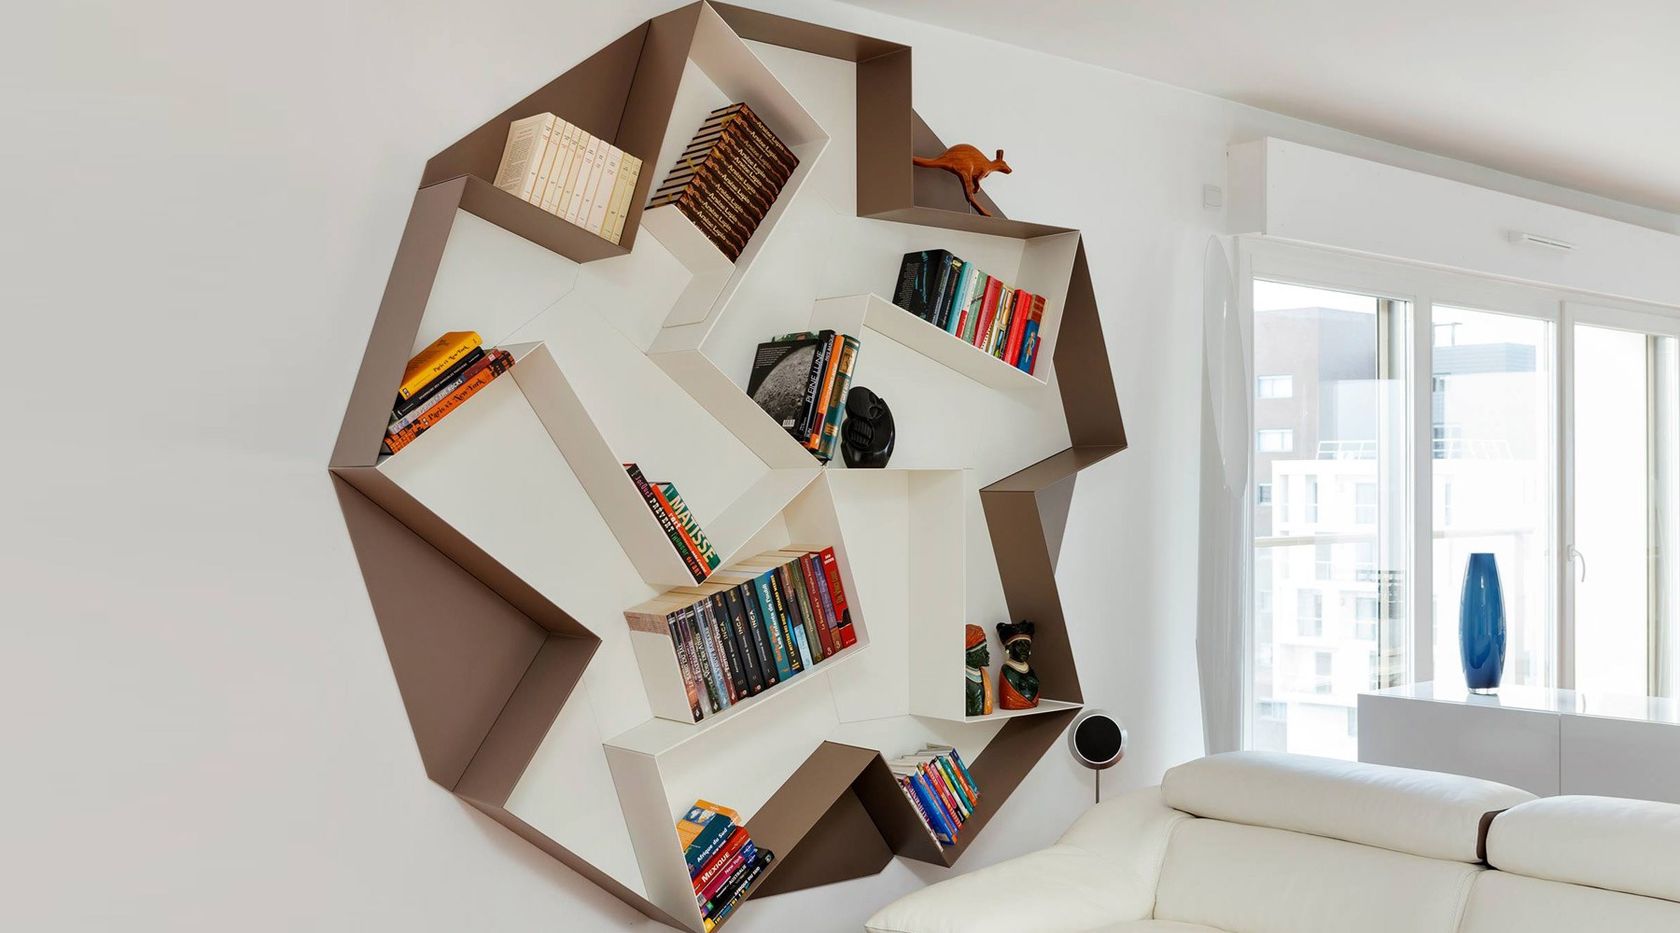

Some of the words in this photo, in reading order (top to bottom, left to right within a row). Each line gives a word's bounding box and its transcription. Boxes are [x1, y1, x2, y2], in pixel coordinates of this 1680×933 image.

[770, 135, 784, 151] Lupin
[764, 145, 778, 161] Lupin
[747, 170, 762, 186] Lupin
[752, 163, 766, 179] Lupin
[742, 178, 756, 195] Lupin
[736, 188, 750, 204] Lupin
[723, 206, 738, 223] Lupin
[729, 197, 744, 214] Lupin
[711, 224, 726, 241] Lupin
[717, 215, 732, 232] Lupin
[805, 374, 816, 403] PLEINE
[813, 351, 823, 375] LUNE
[428, 406, 445, 420] Paris
[453, 392, 468, 403] New
[468, 378, 486, 391] York
[650, 496, 675, 532] PRÉVERT
[670, 495, 716, 562] MATISSE
[734, 615, 743, 634] INCA
[749, 609, 758, 628] INCA
[719, 620, 728, 640] INCA
[697, 844, 713, 863] Afrique
[718, 827, 728, 838] Sud
[701, 852, 730, 883] MEXIQUE
[724, 864, 734, 875] New
[729, 865, 747, 885] AUSTRALIE
[734, 880, 749, 896] AFRIQUE
[752, 866, 760, 876] SUD
